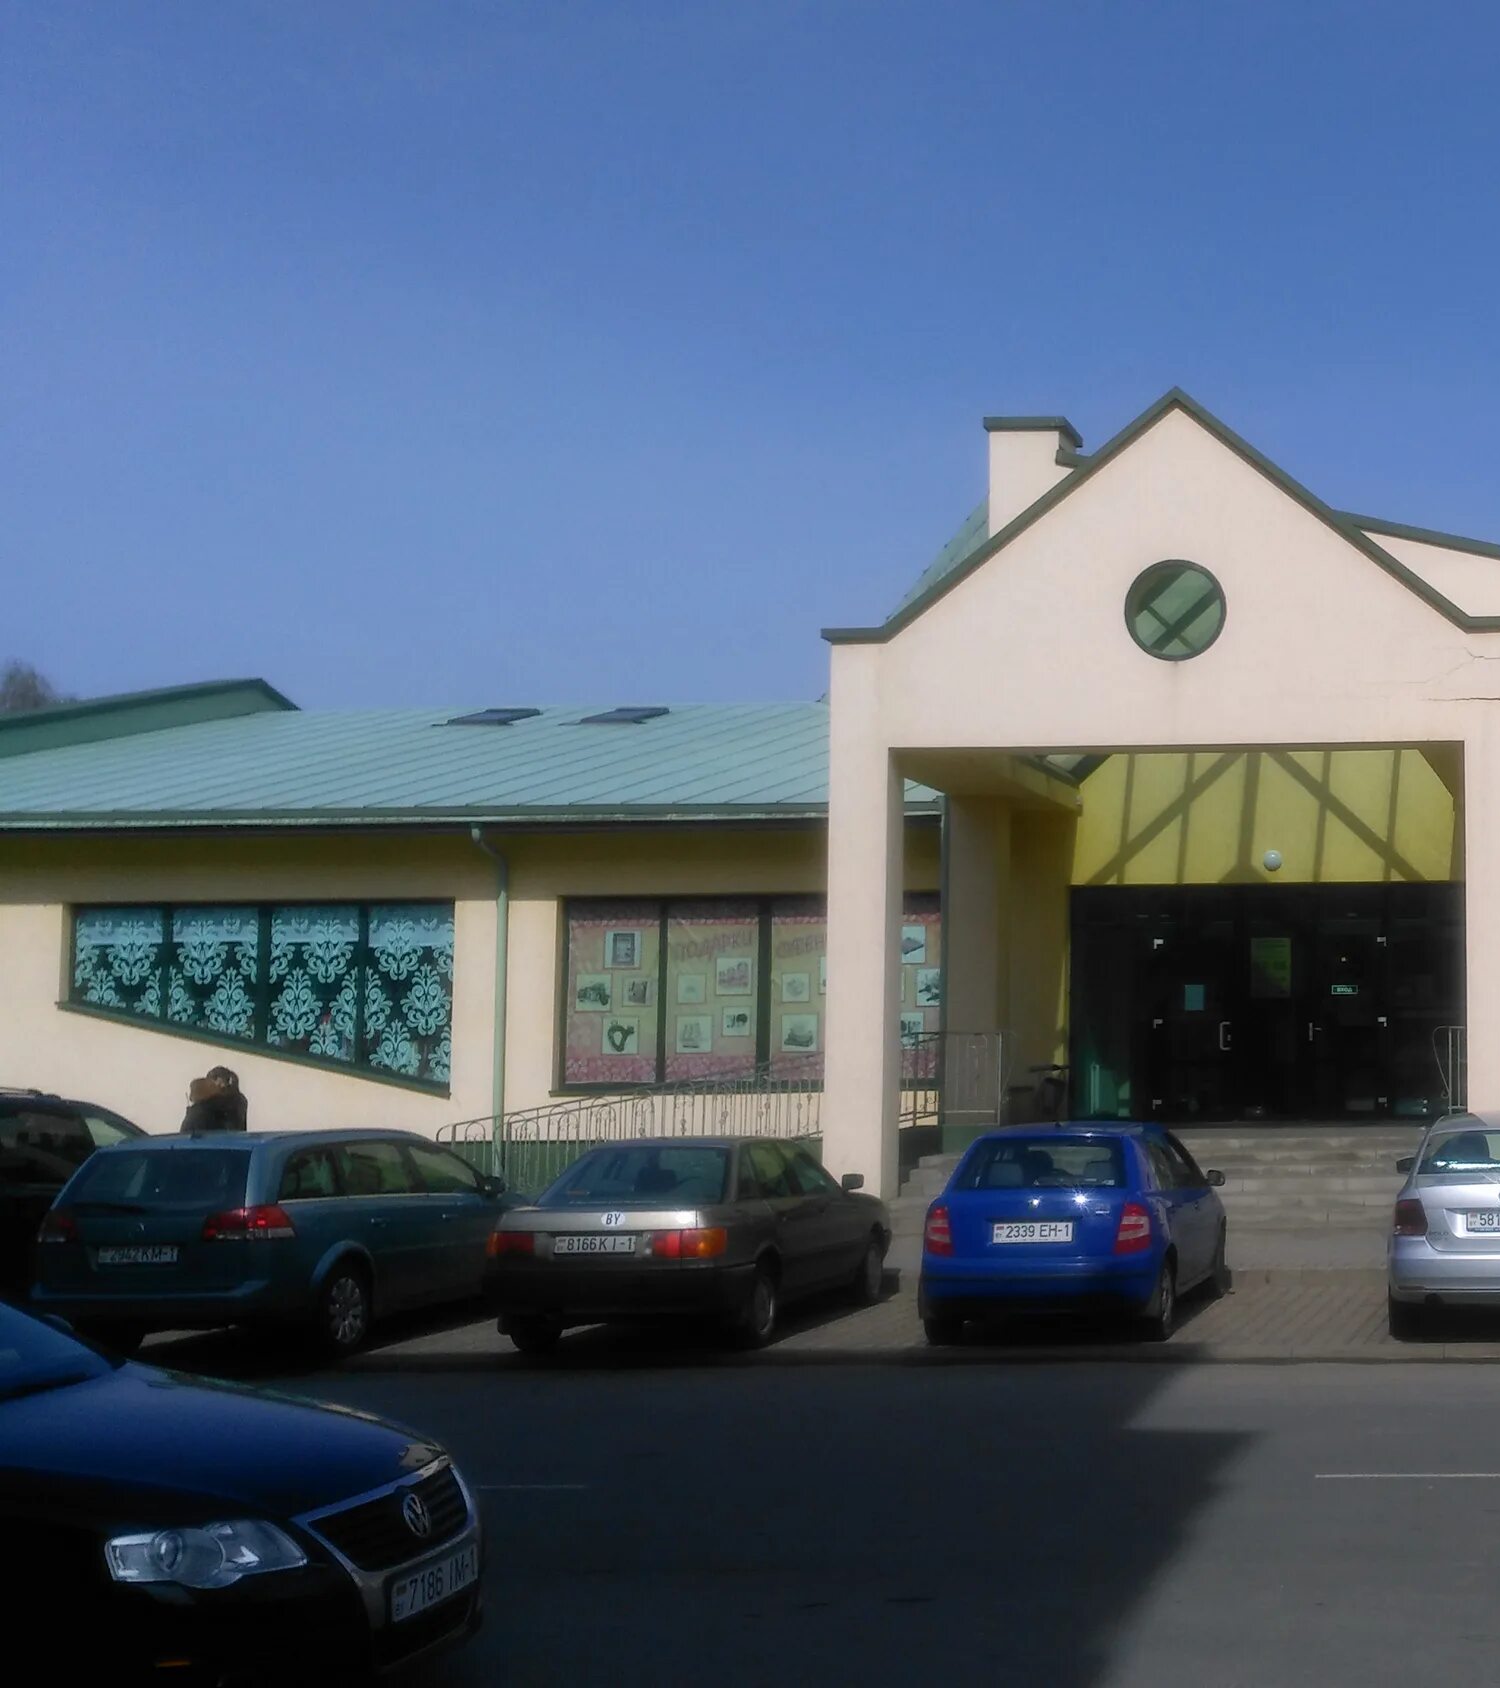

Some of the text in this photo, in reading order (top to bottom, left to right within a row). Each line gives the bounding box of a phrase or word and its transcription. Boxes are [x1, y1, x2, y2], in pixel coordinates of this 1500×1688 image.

[605, 1213, 621, 1225] BY
[1005, 1224, 1071, 1239] 2339 EH-1
[408, 1567, 443, 1610] 7186
